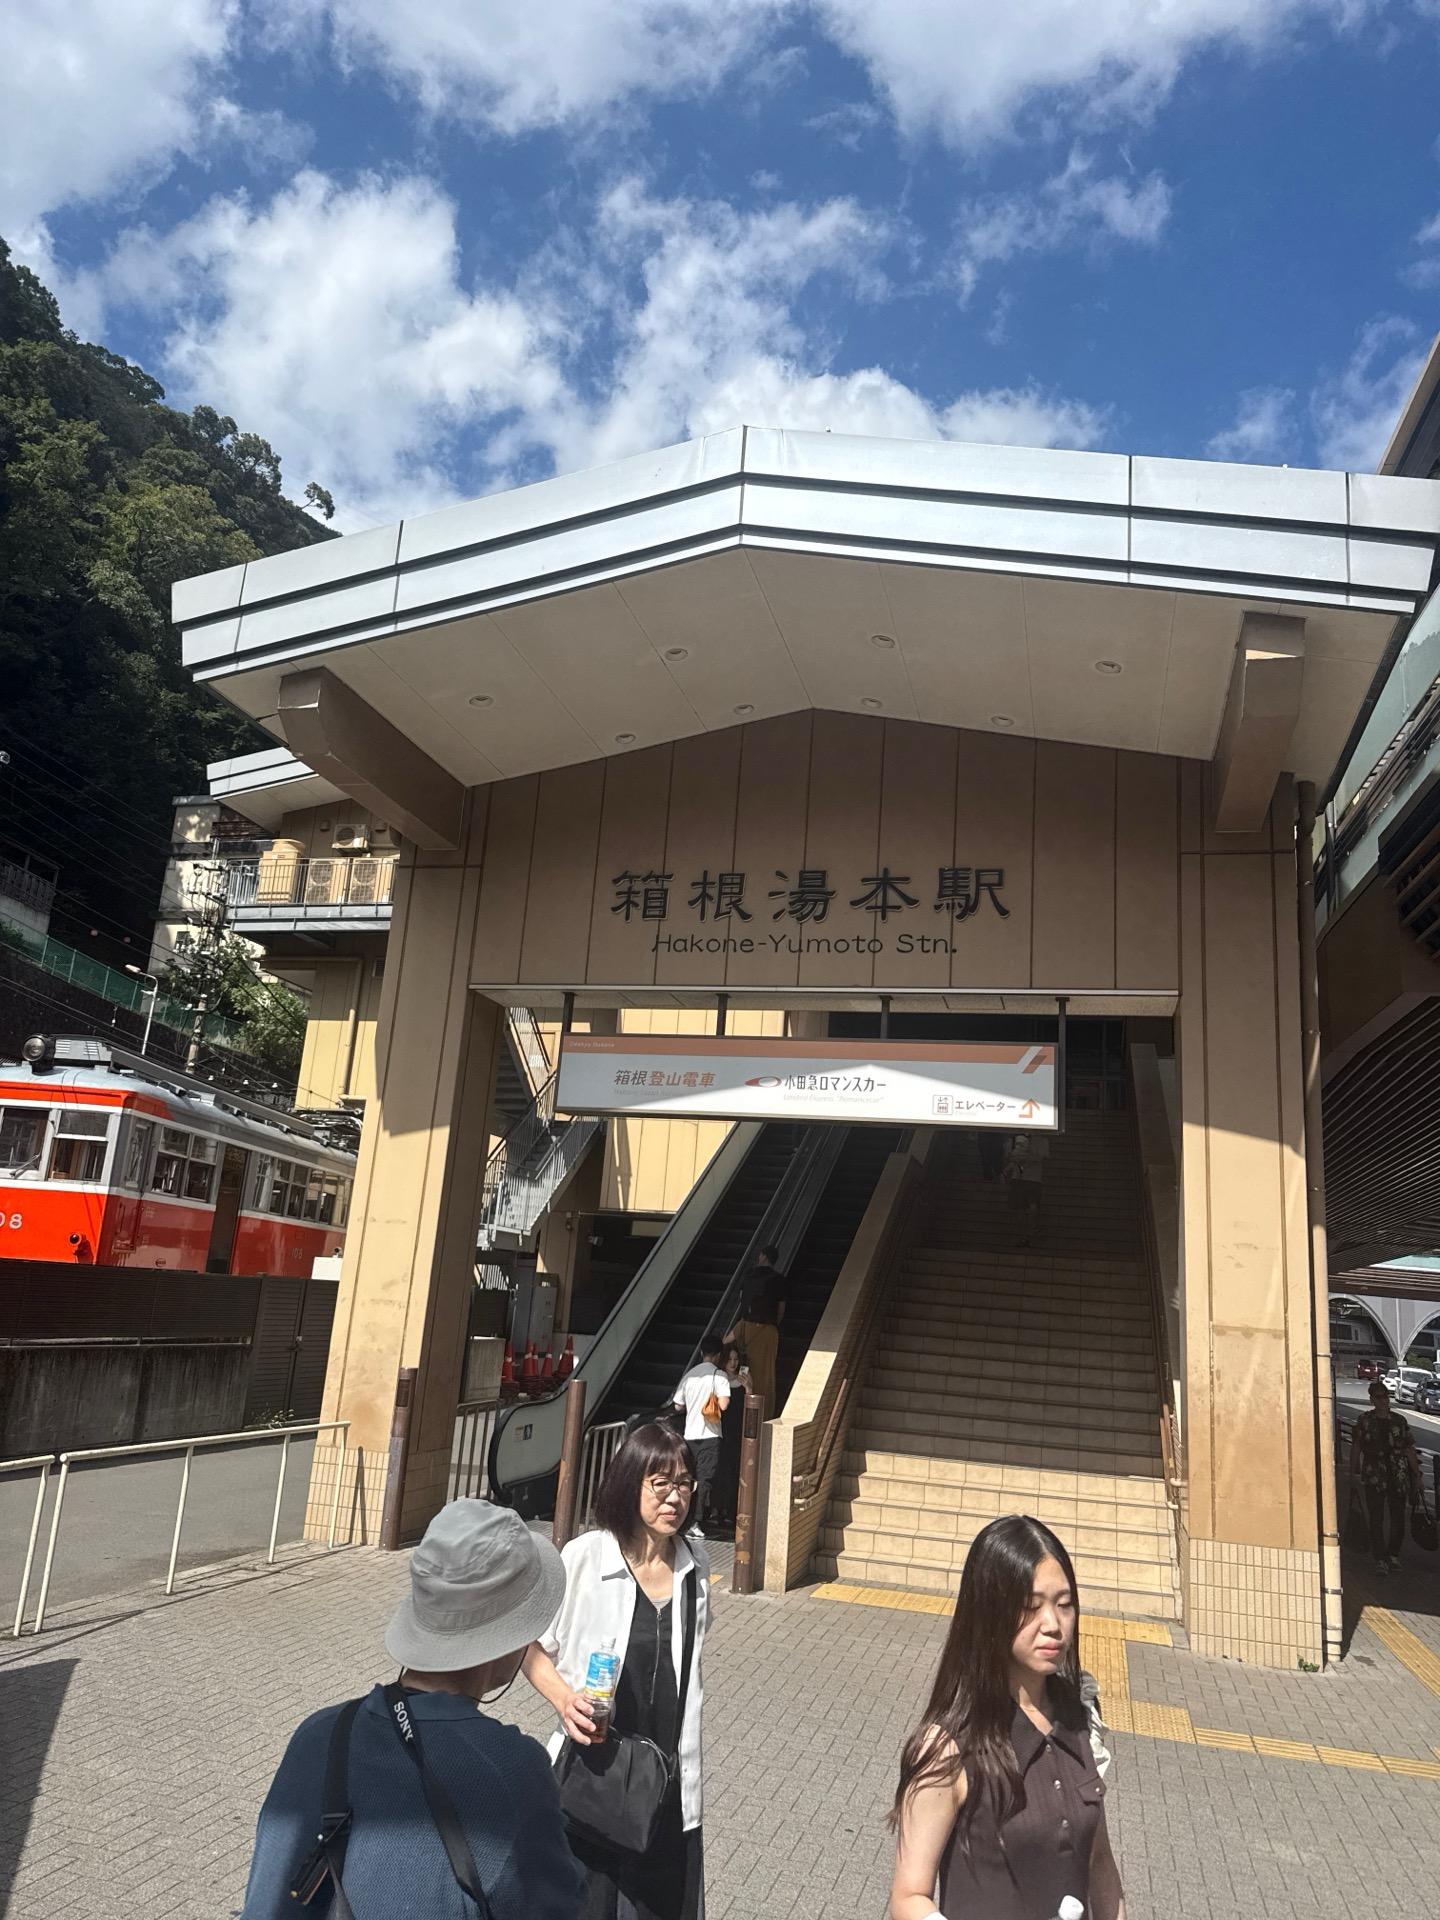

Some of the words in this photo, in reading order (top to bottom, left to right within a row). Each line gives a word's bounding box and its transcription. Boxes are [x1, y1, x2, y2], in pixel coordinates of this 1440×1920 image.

[611, 867, 1010, 922] 箱根湯本駅
[651, 933, 884, 954] Hakone-Yumoto
[896, 933, 958, 954] Stn.
[614, 1069, 716, 1088] 箱根登山電車
[784, 1074, 887, 1092] 小田急ロマンスカー
[955, 1100, 1017, 1112] エレベーター
[393, 1700, 414, 1743] SONY
